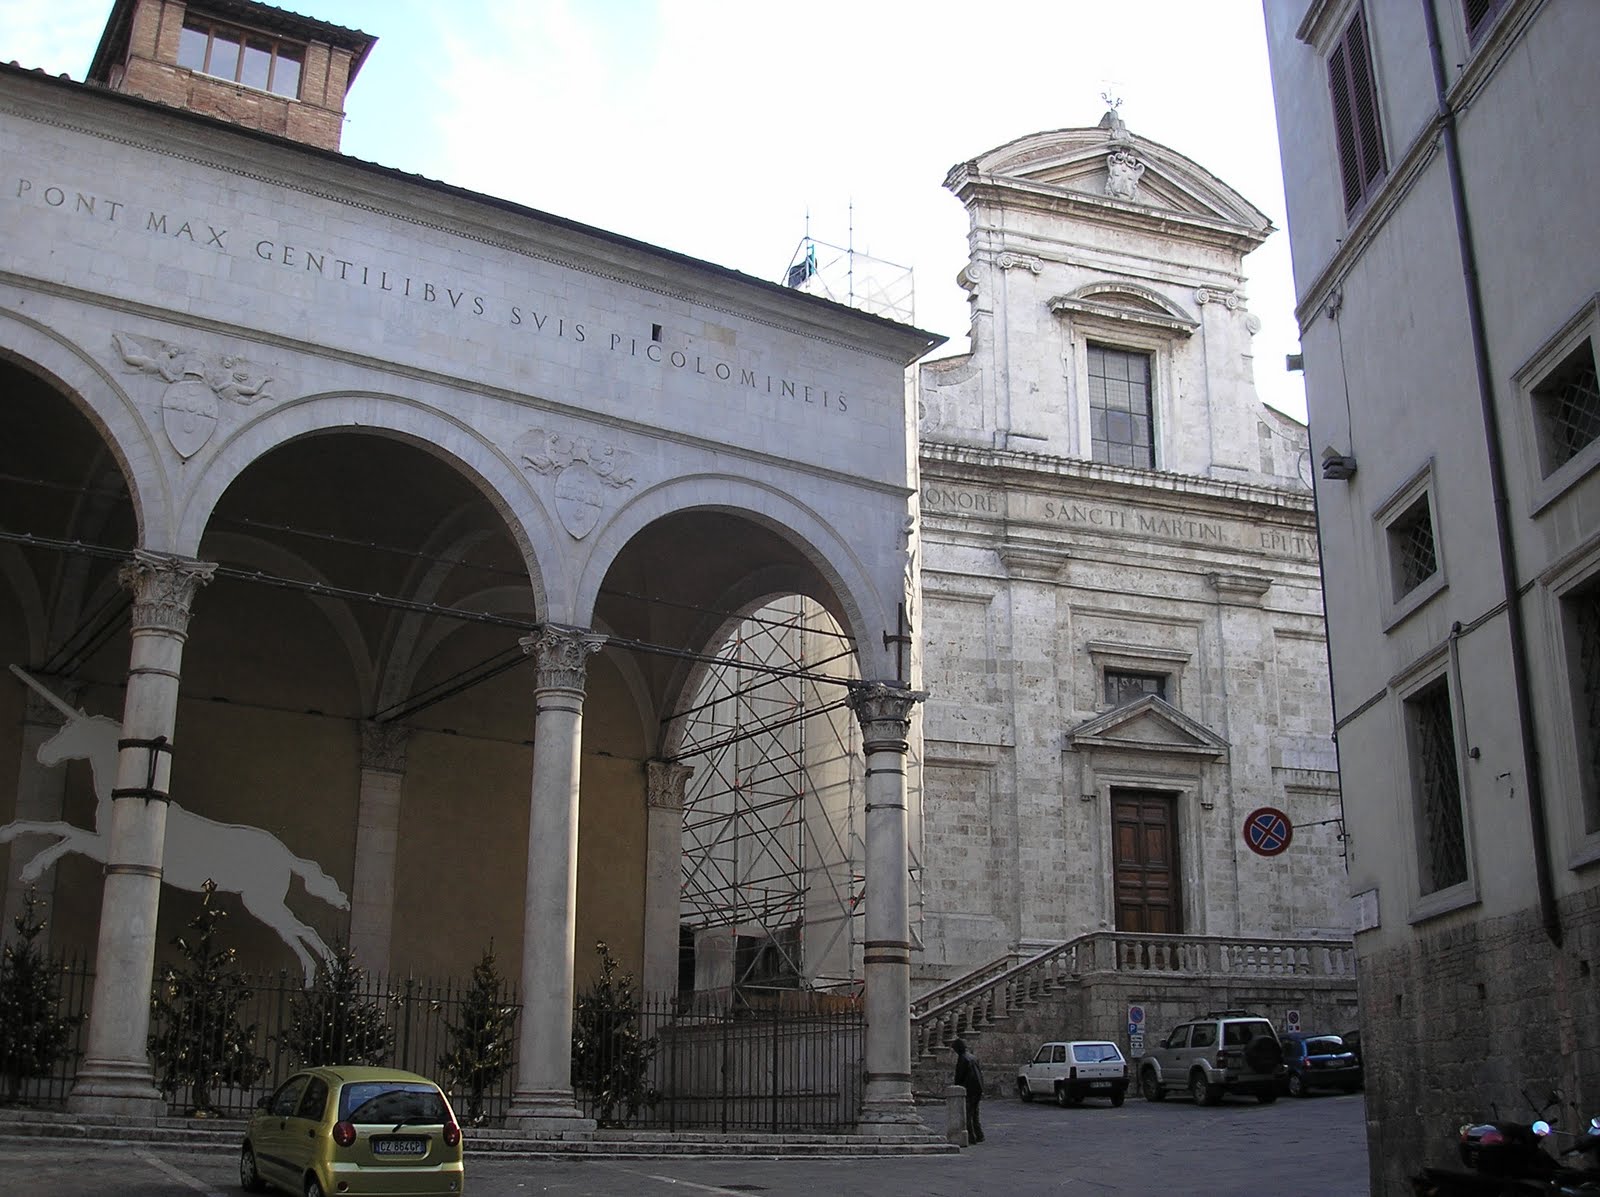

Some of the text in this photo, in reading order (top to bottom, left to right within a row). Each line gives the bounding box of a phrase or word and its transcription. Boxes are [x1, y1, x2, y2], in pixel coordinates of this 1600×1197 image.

[17, 179, 849, 412] PONT MAX GENTILIBVS SVIS PICOLOMINEIS
[920, 486, 998, 513] ONORE
[1044, 502, 1126, 528] SANCTI
[1139, 514, 1223, 542] MARTINI
